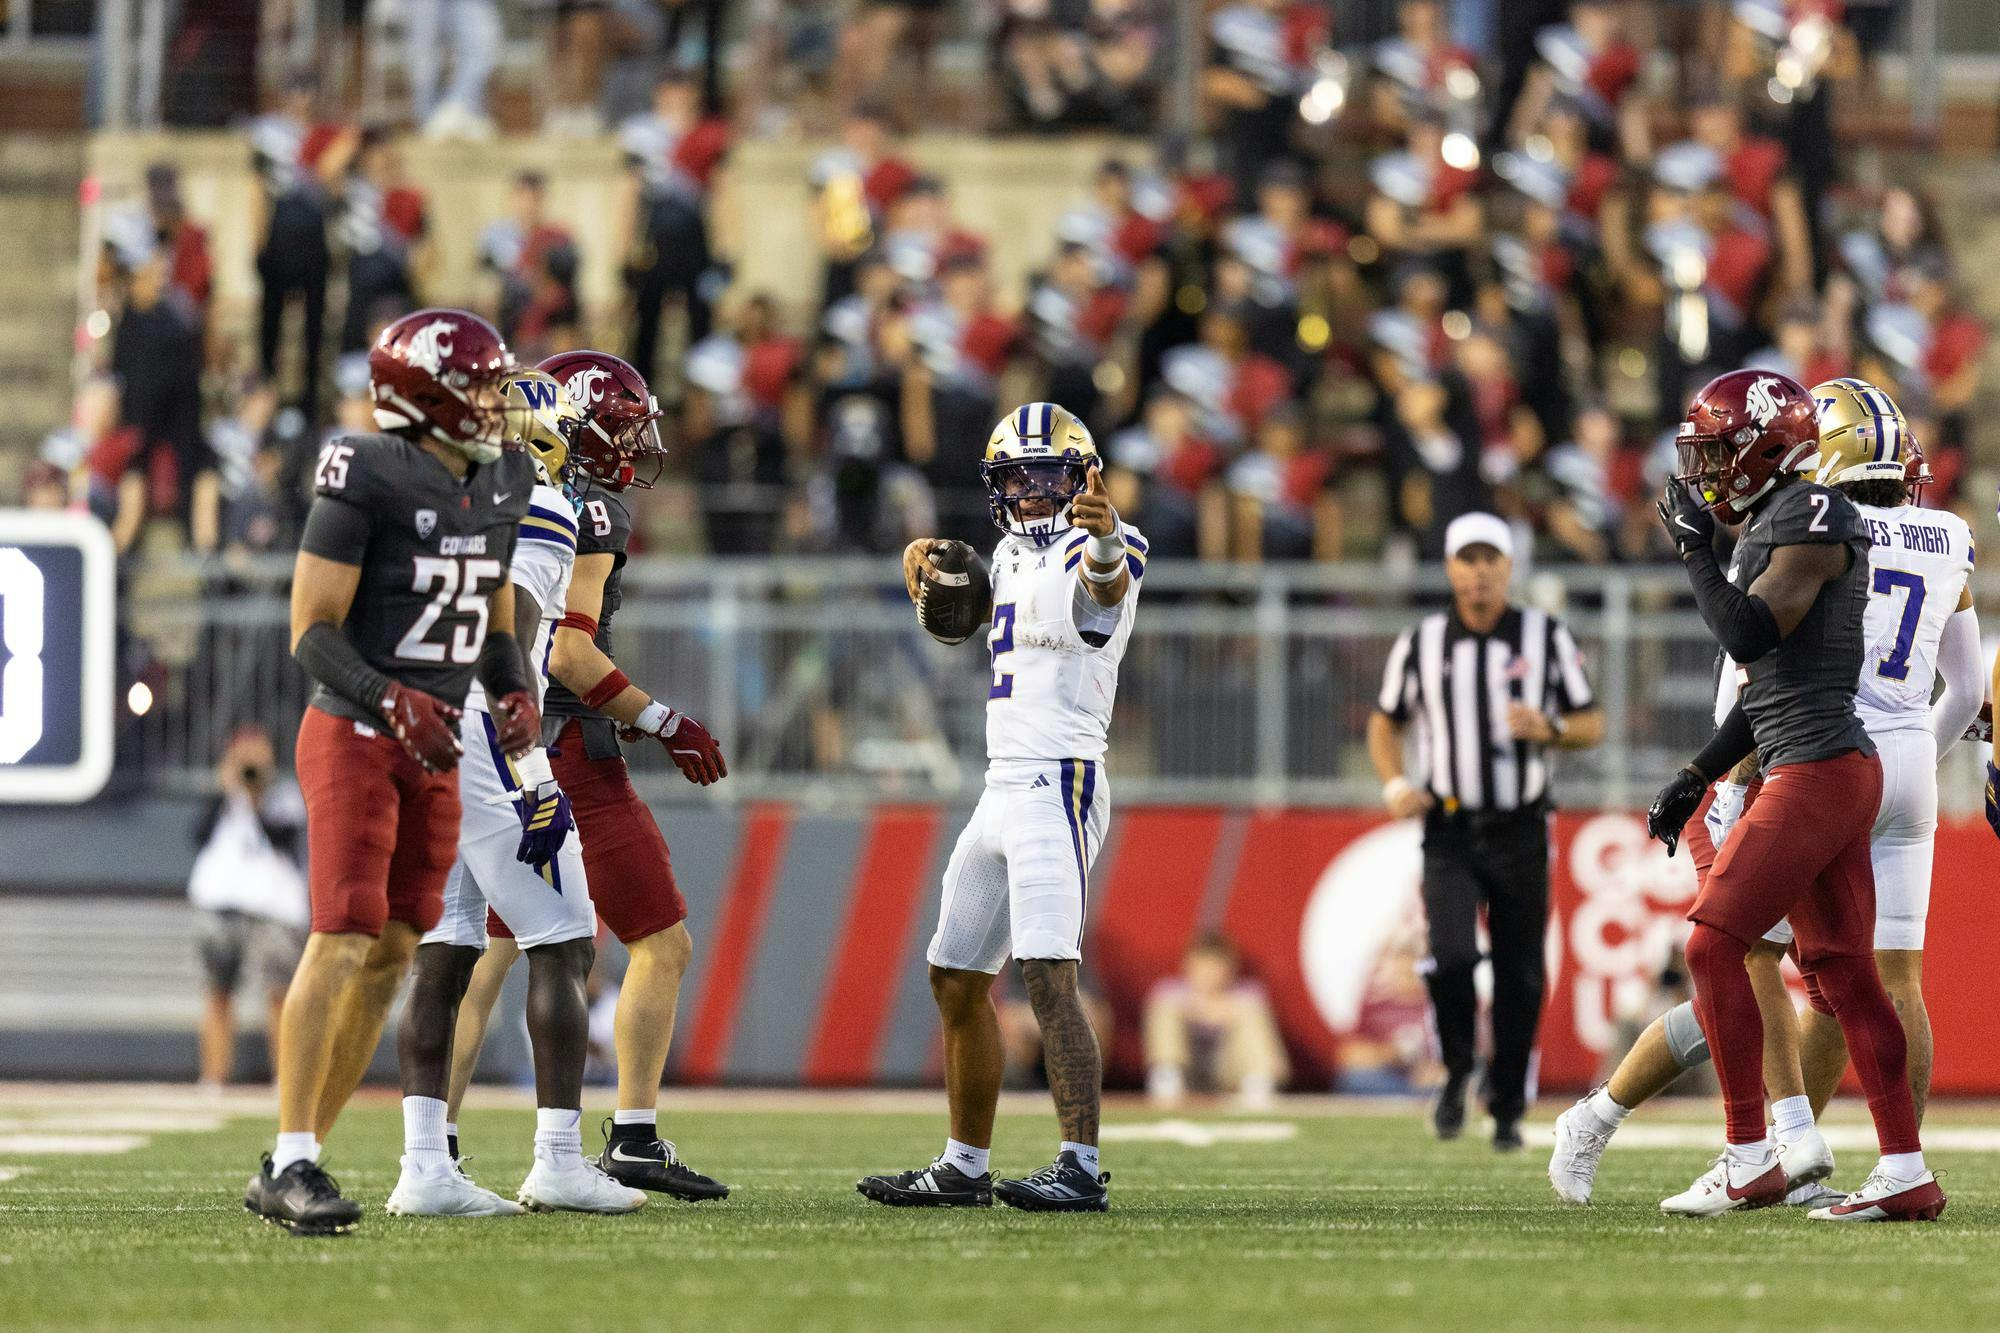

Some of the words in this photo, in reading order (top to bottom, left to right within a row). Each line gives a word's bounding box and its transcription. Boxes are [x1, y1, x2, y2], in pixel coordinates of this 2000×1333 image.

[515, 380, 558, 411] W
[585, 499, 612, 537] 9
[1808, 493, 1830, 533] 2
[439, 534, 488, 556] COUGARS
[1029, 522, 1052, 548] W
[394, 555, 501, 664] 25
[1873, 567, 1927, 684] 7
[988, 602, 1017, 700] 2
